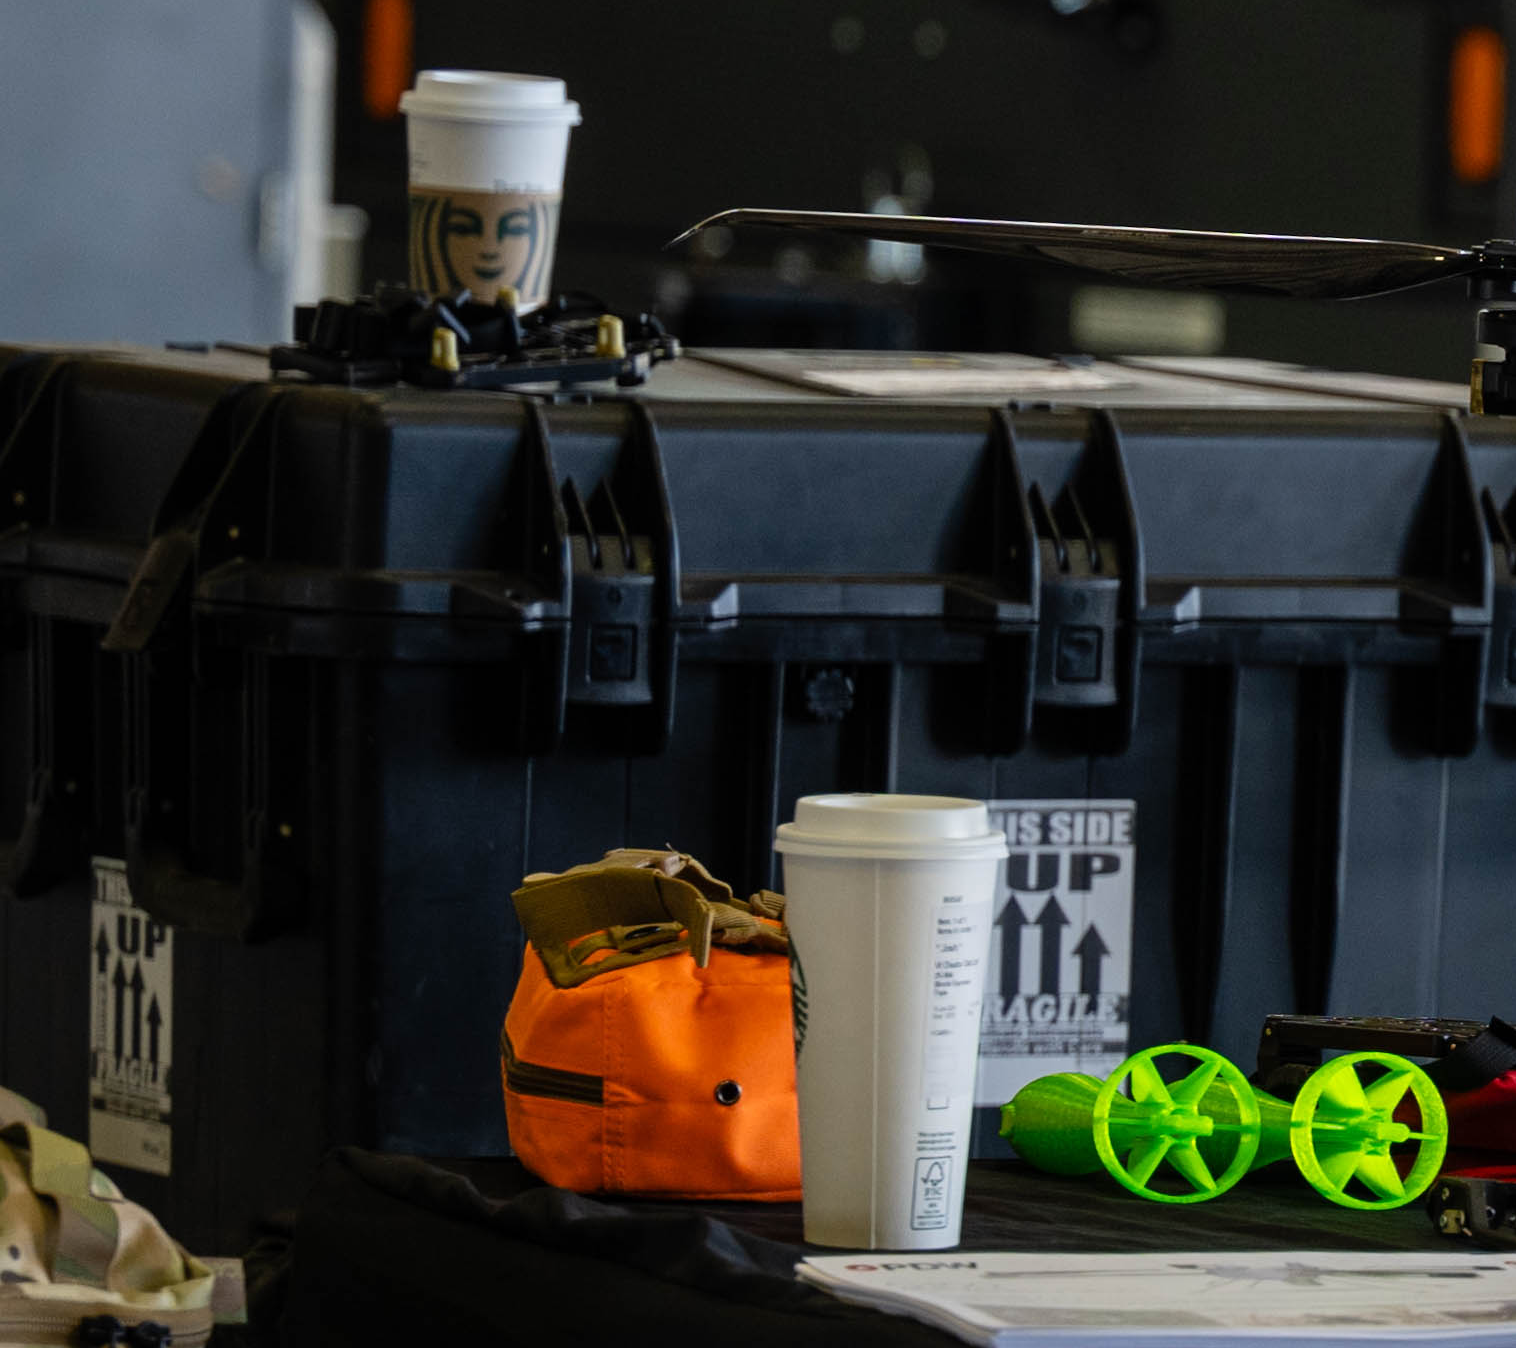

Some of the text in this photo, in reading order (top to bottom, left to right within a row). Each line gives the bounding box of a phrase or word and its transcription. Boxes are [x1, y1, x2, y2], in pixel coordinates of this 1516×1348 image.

[990, 809, 1133, 845] IS SIDE
[1005, 853, 1121, 892] UP
[116, 912, 167, 960] UP
[983, 993, 1120, 1024] RAGILE
